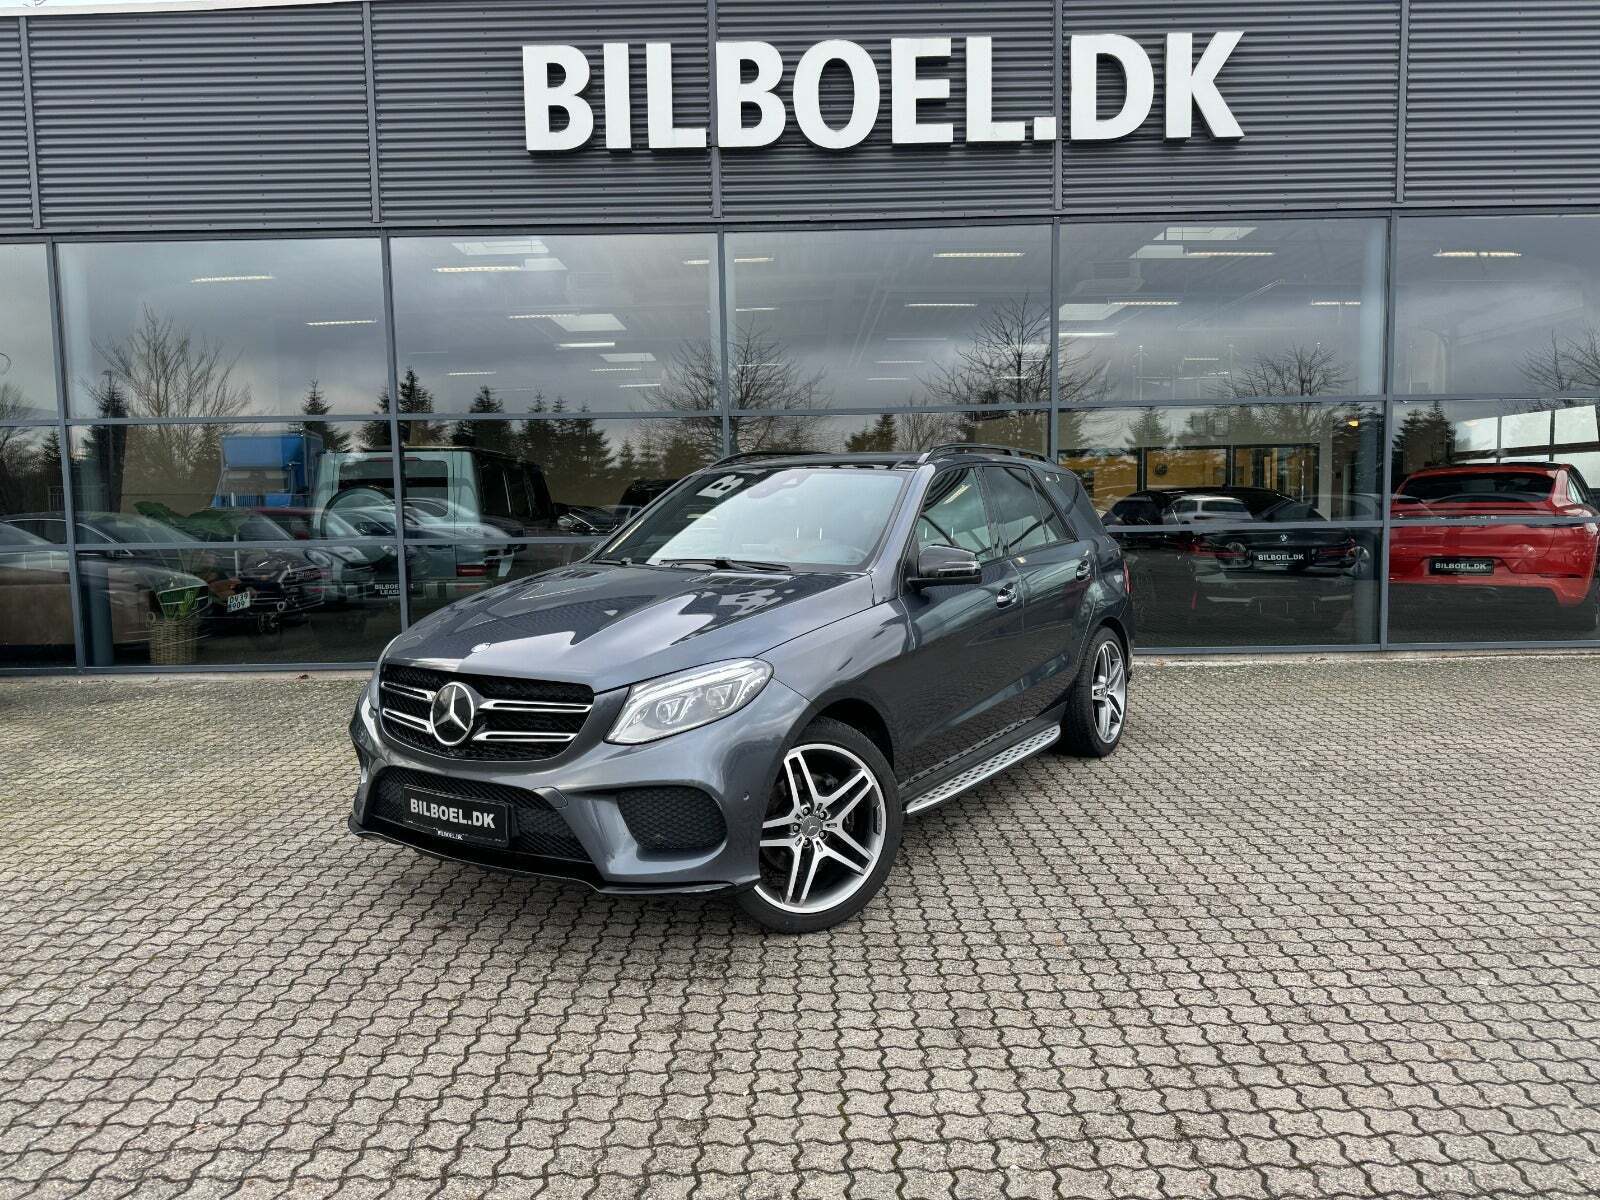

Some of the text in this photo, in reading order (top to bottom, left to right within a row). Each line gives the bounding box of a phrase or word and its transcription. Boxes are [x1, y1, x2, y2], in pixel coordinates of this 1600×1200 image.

[522, 31, 1246, 153] BILBOEL.DK
[1257, 553, 1304, 561] BILBOEL.DK
[1435, 562, 1487, 570] BILBOEL.DK
[410, 798, 496, 829] BILBOEL.DK
